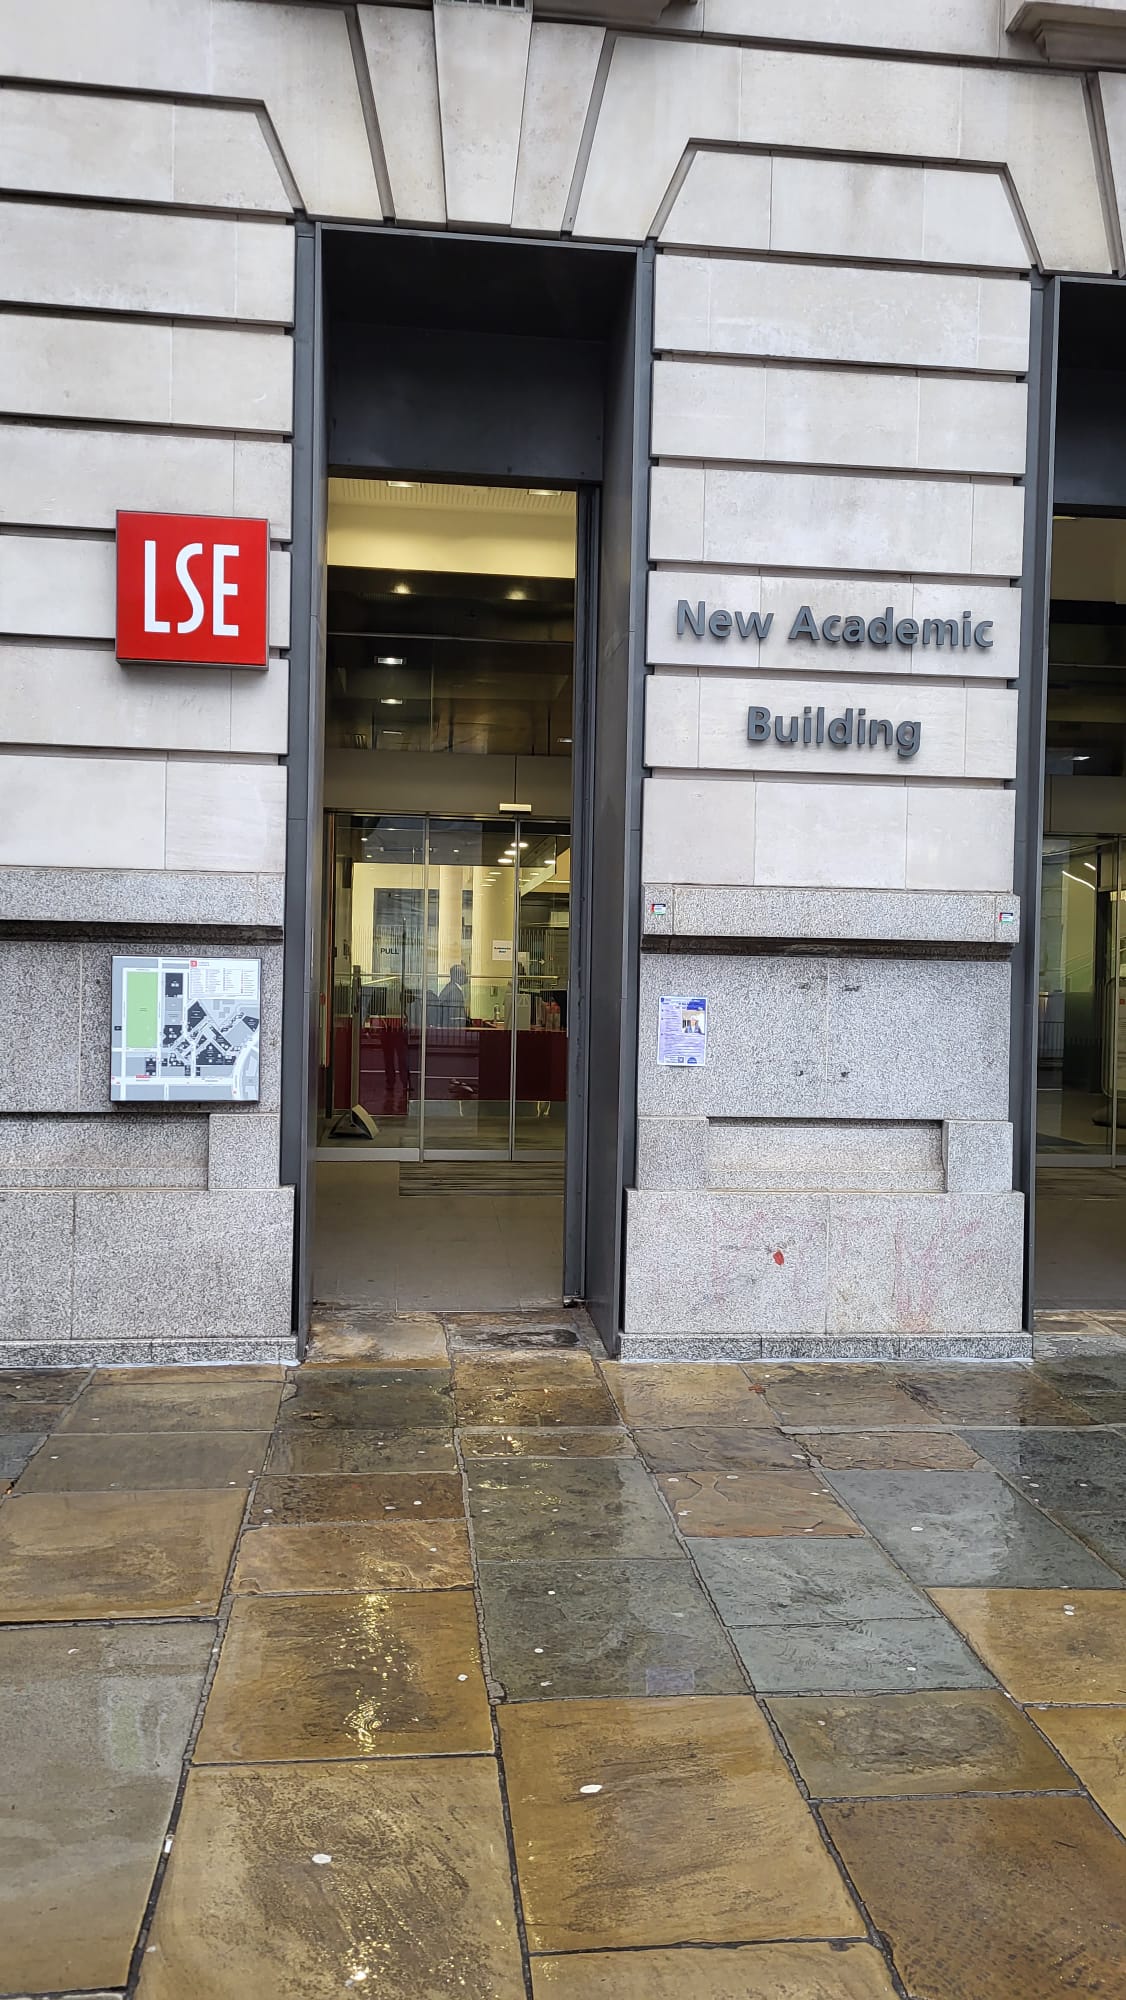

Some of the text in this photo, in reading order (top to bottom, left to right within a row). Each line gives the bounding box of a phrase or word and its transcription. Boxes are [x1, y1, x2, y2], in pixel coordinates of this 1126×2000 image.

[144, 539, 240, 637] LSE
[676, 599, 994, 648] New Academic
[747, 705, 922, 757] Building
[380, 947, 400, 955] PULL
